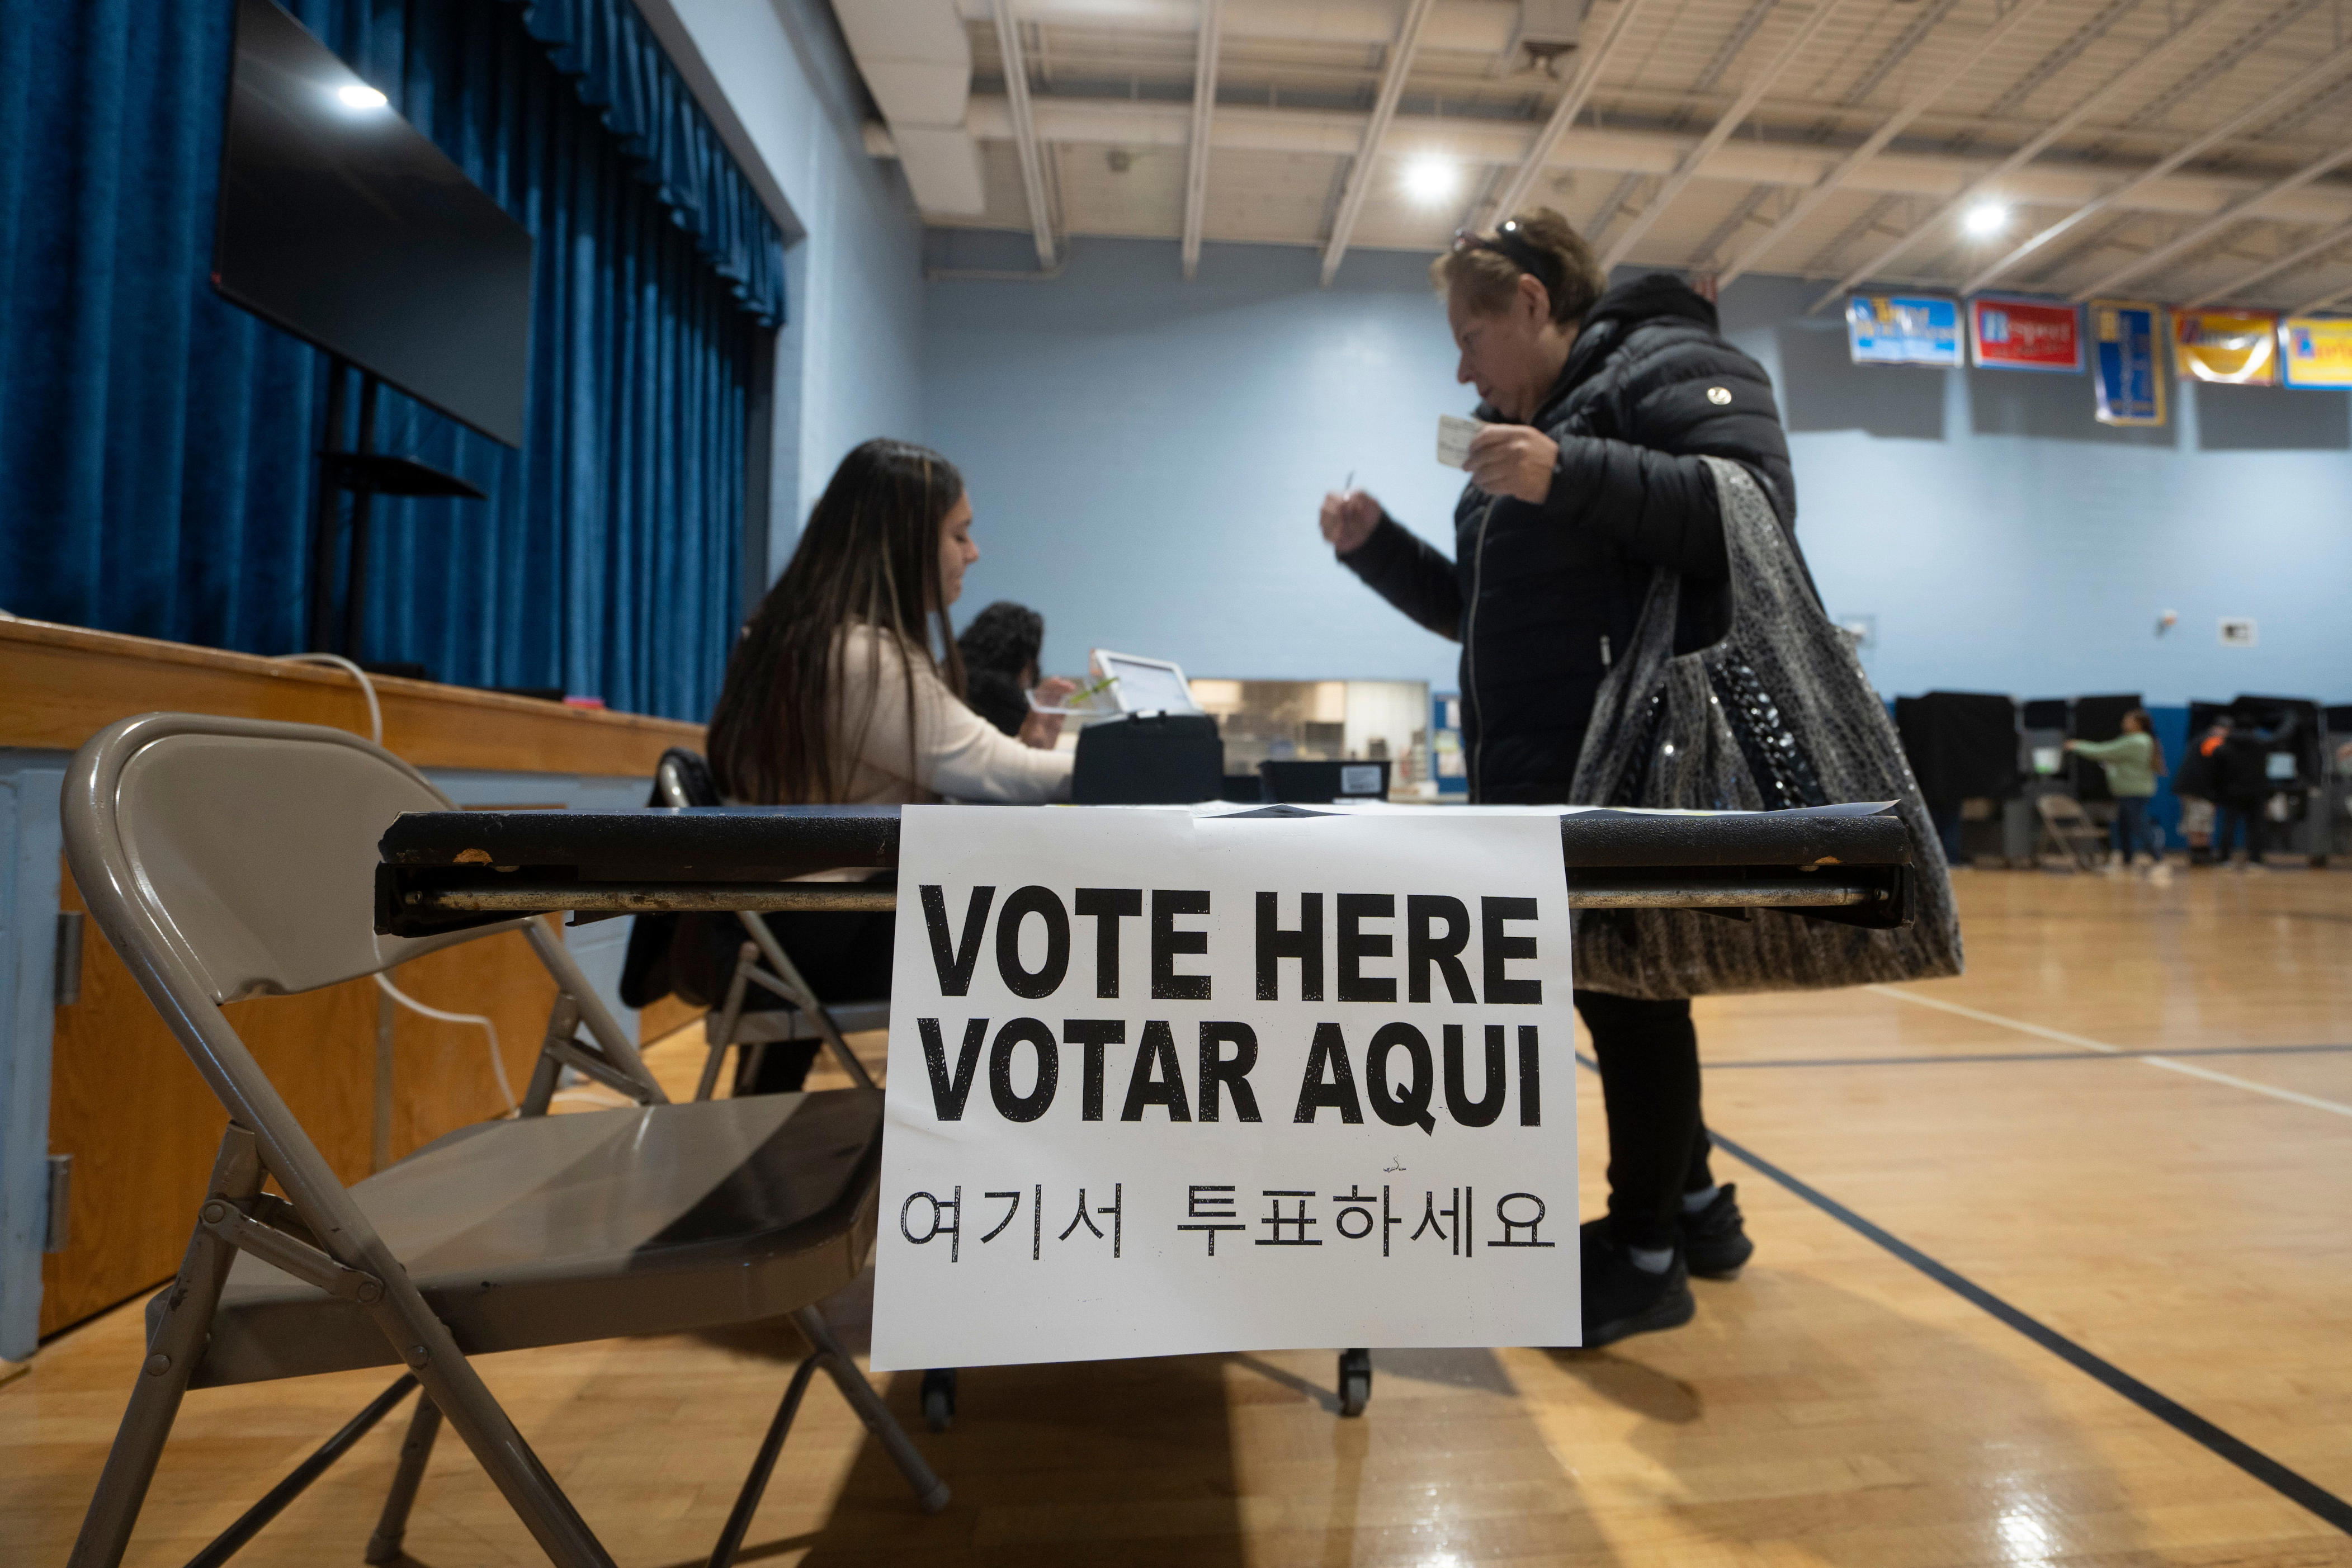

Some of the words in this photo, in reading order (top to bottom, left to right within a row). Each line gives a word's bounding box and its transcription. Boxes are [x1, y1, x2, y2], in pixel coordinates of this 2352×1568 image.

[919, 885, 1211, 1000] VOTE
[1256, 892, 1542, 1004] HERE
[917, 1018, 1262, 1122] VOTAR
[1293, 1022, 1541, 1136] AQUI
[901, 1183, 1121, 1262] 여기서
[1178, 1185, 1555, 1257] 투표하세요
